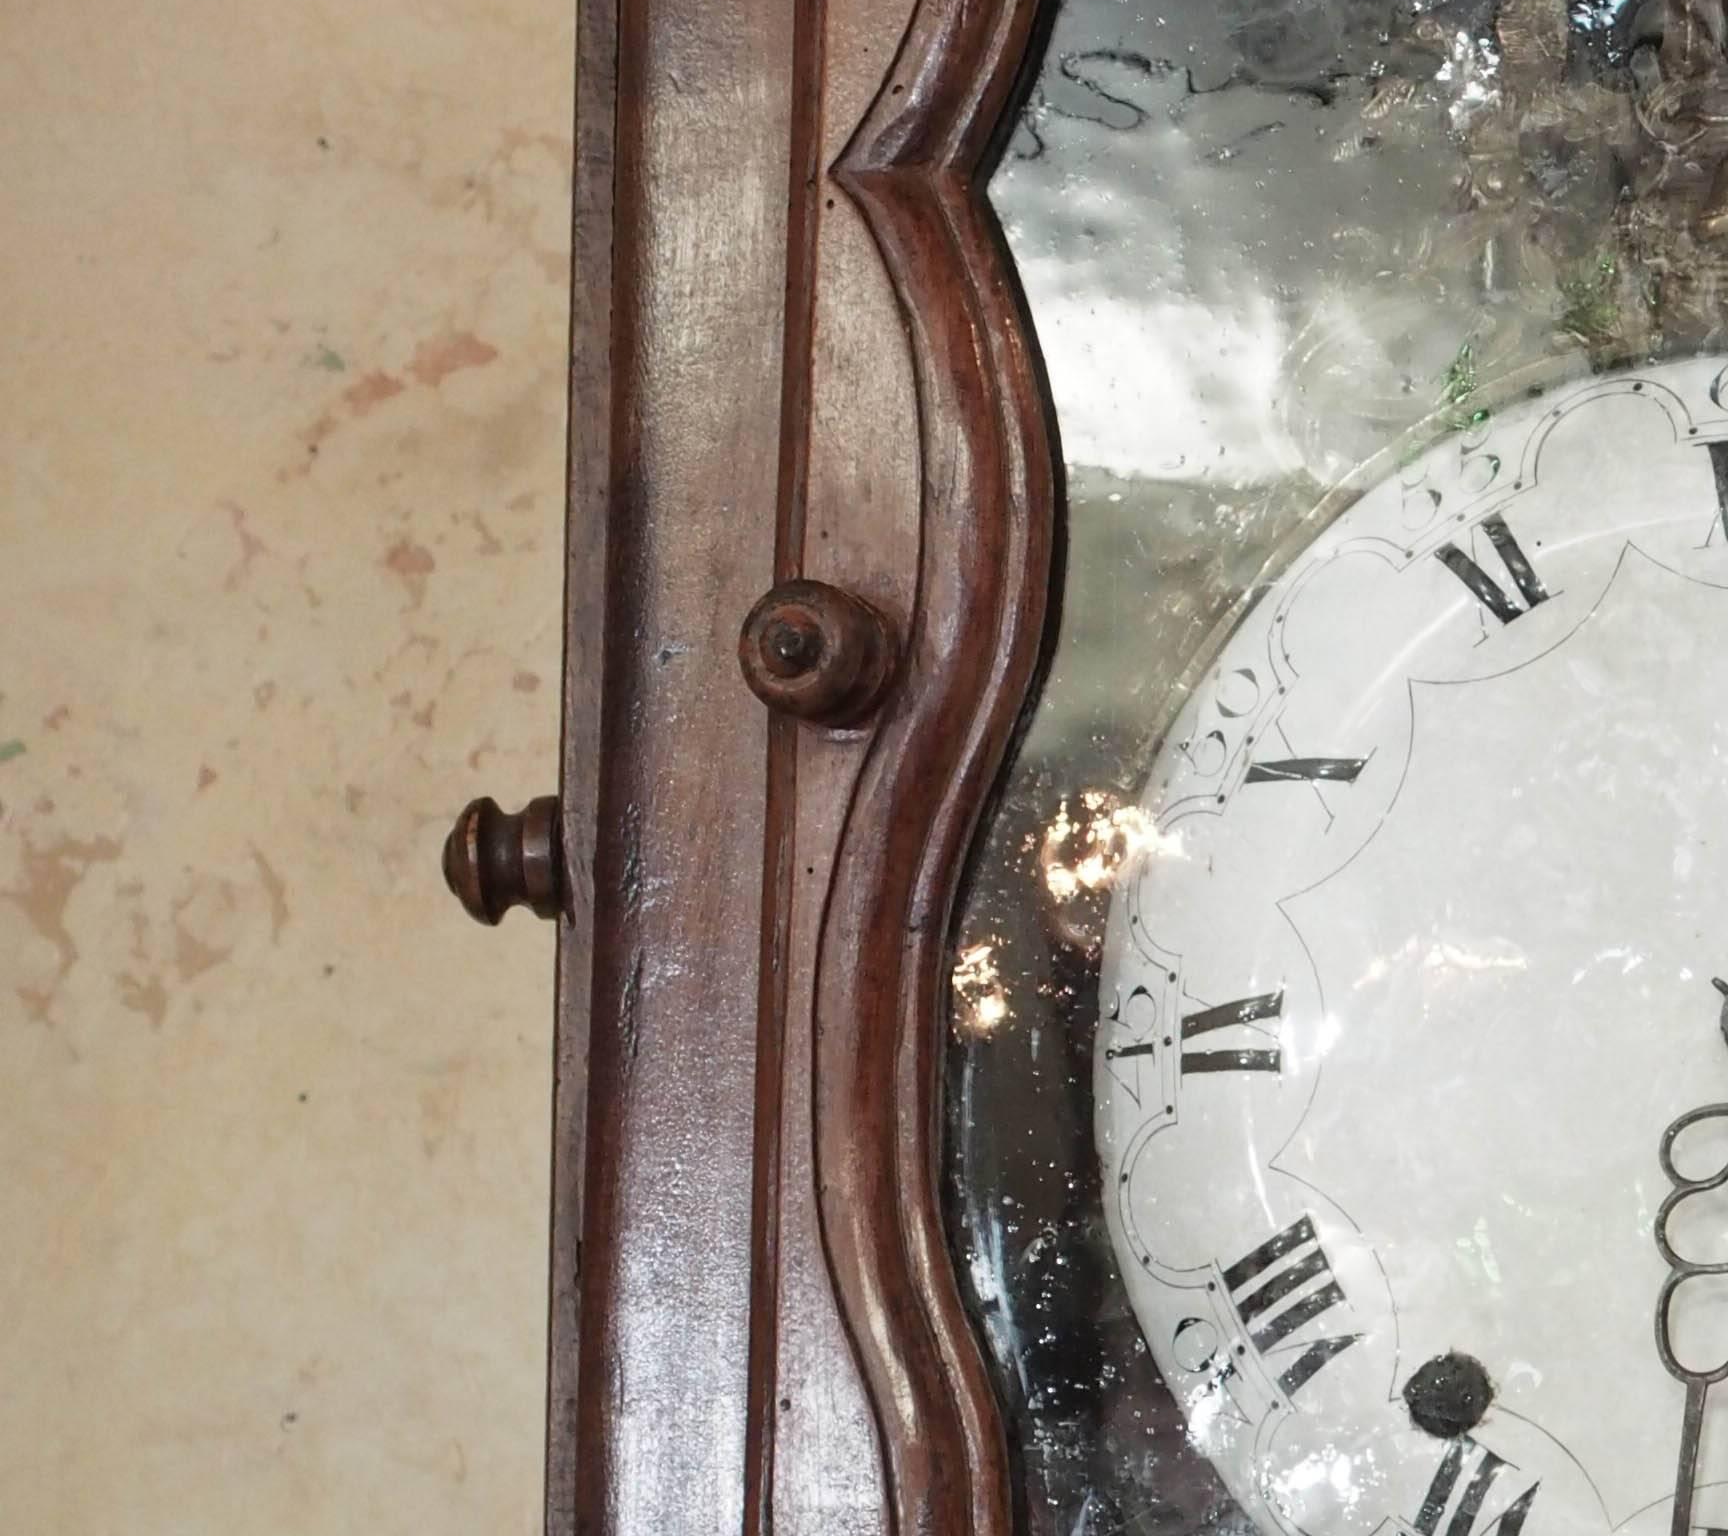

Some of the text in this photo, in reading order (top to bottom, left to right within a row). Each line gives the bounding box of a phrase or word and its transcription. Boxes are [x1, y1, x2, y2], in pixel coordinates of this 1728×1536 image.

[1401, 426, 1501, 532] 55
[1424, 502, 1565, 649] XI
[1179, 667, 1260, 778] 50
[1238, 708, 1378, 835] X
[1104, 983, 1157, 1111] 45
[1180, 976, 1285, 1091] IX
[1214, 1211, 1366, 1413] VIII
